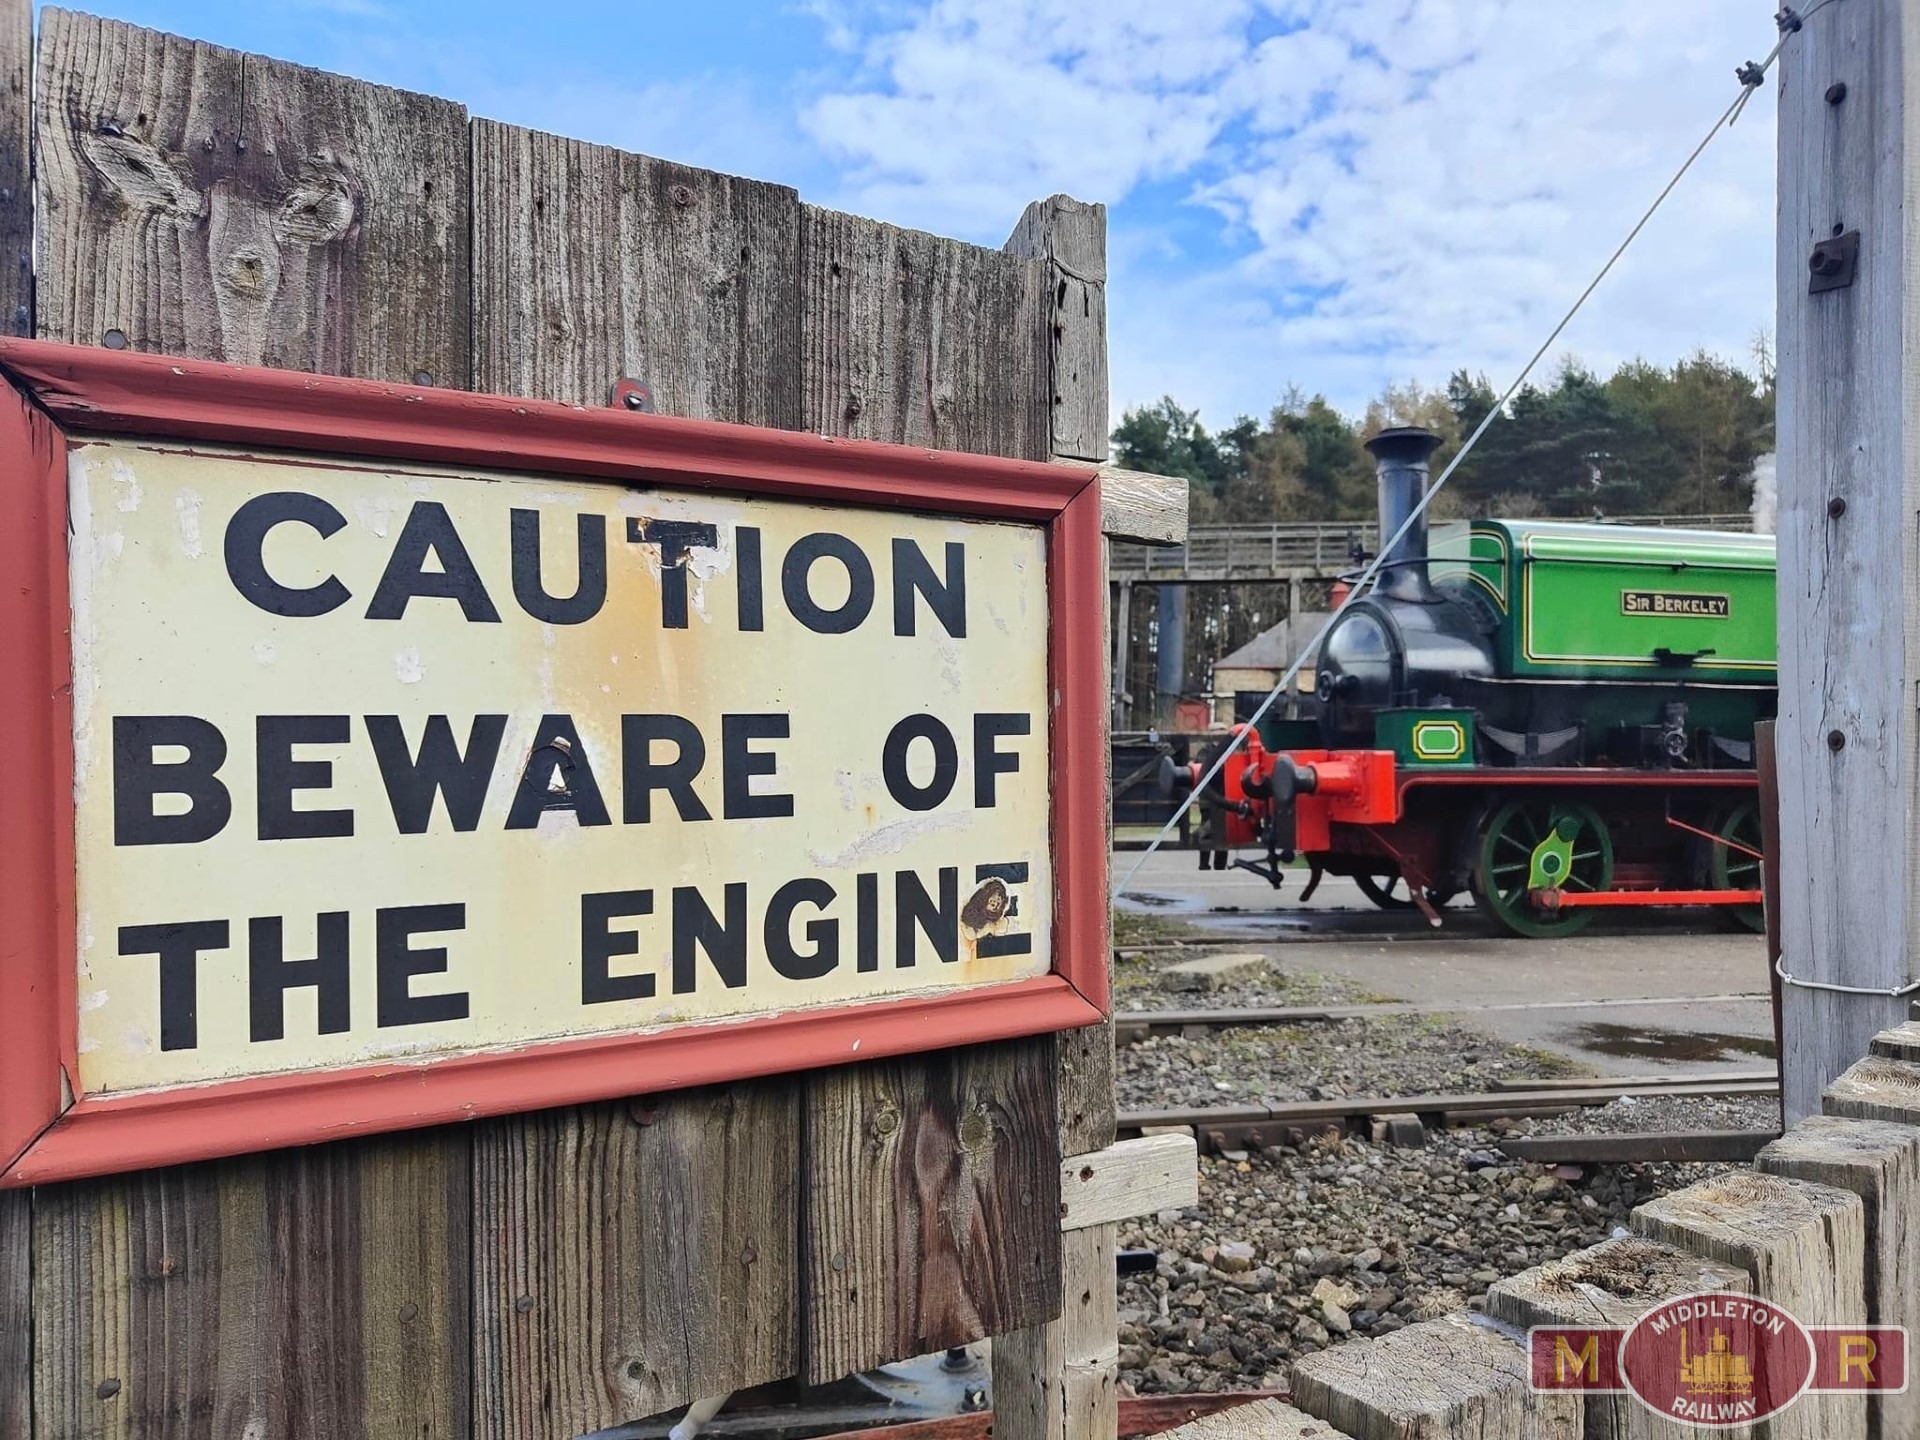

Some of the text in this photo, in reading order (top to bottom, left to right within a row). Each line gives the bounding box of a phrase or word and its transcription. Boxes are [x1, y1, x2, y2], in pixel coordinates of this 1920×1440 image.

[224, 491, 967, 639] CAUTION
[1626, 594, 1726, 613] SIR BERKELEY
[112, 712, 1032, 846] BEWARE OF
[118, 861, 1033, 1052] THE ENGINE
